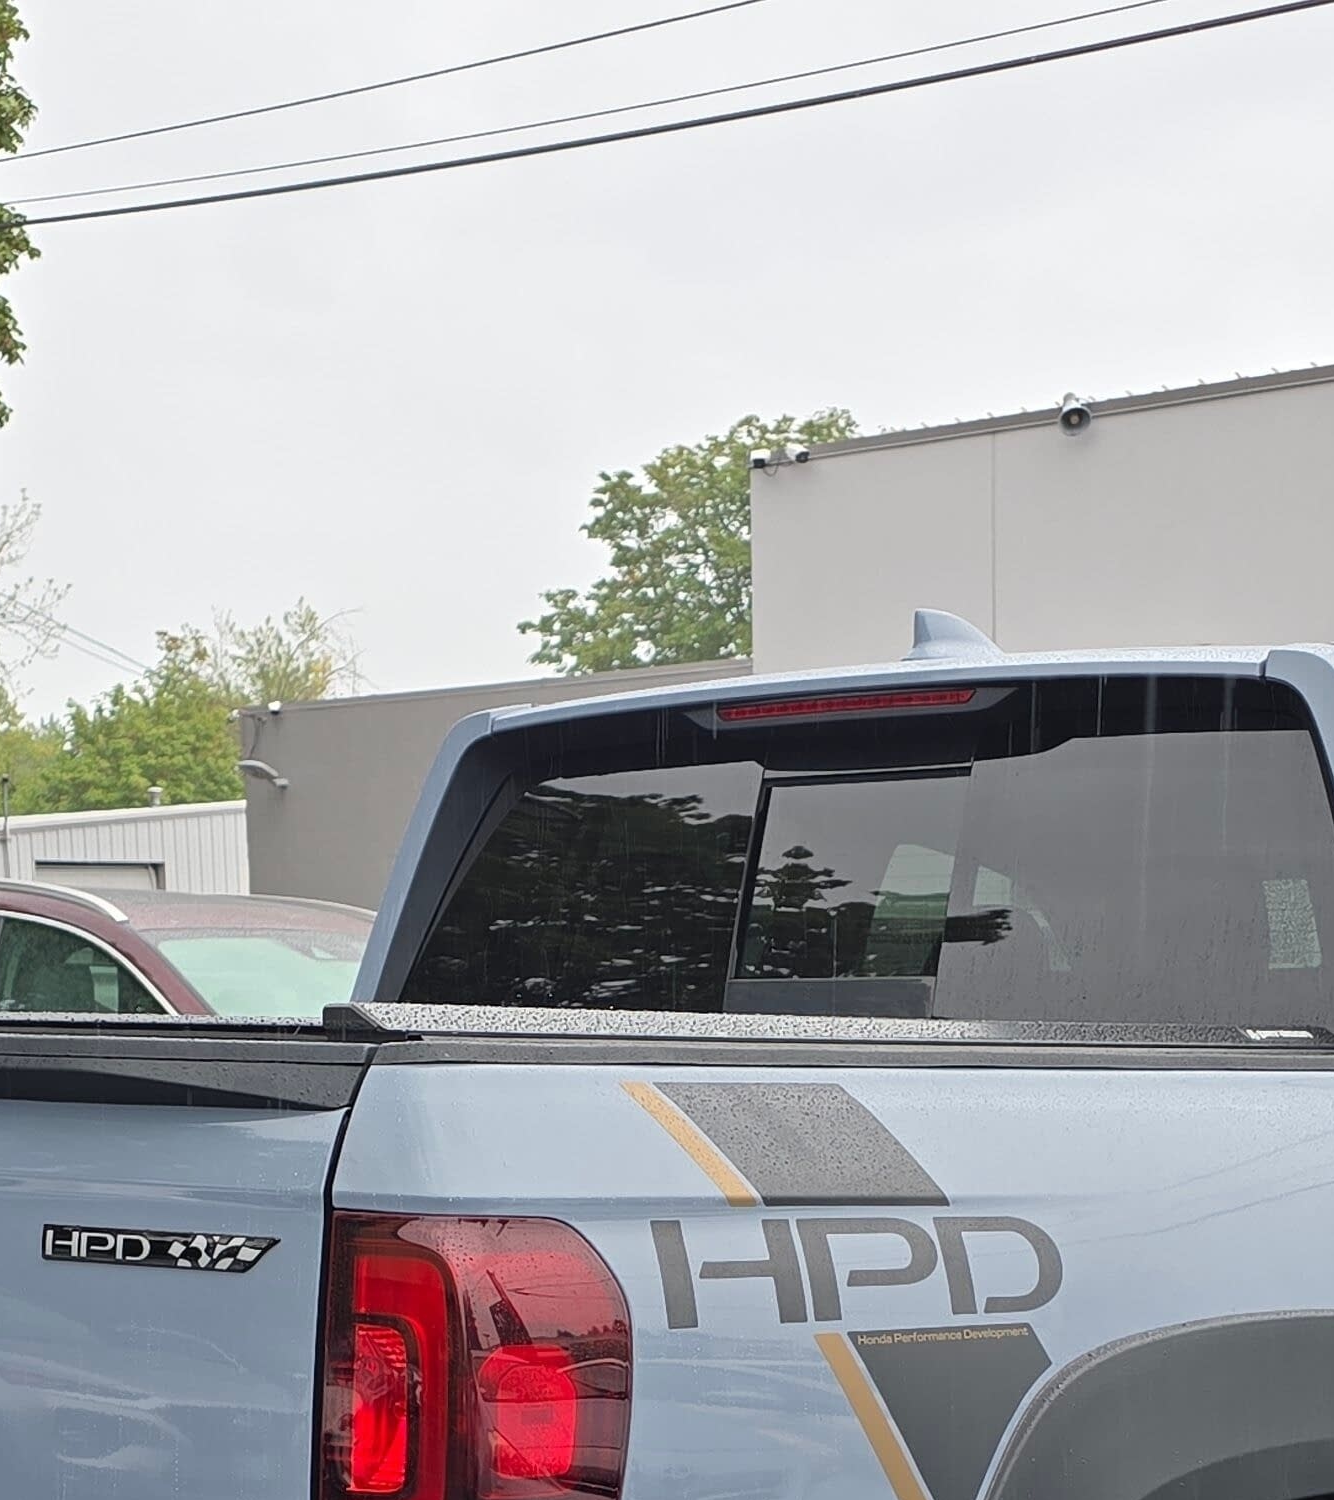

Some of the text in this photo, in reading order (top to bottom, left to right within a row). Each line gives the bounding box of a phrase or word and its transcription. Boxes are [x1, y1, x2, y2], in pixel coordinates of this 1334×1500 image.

[45, 1228, 151, 1261] HPD
[650, 1215, 1063, 1330] HPD
[857, 1326, 1030, 1346] Honda Performance Development
